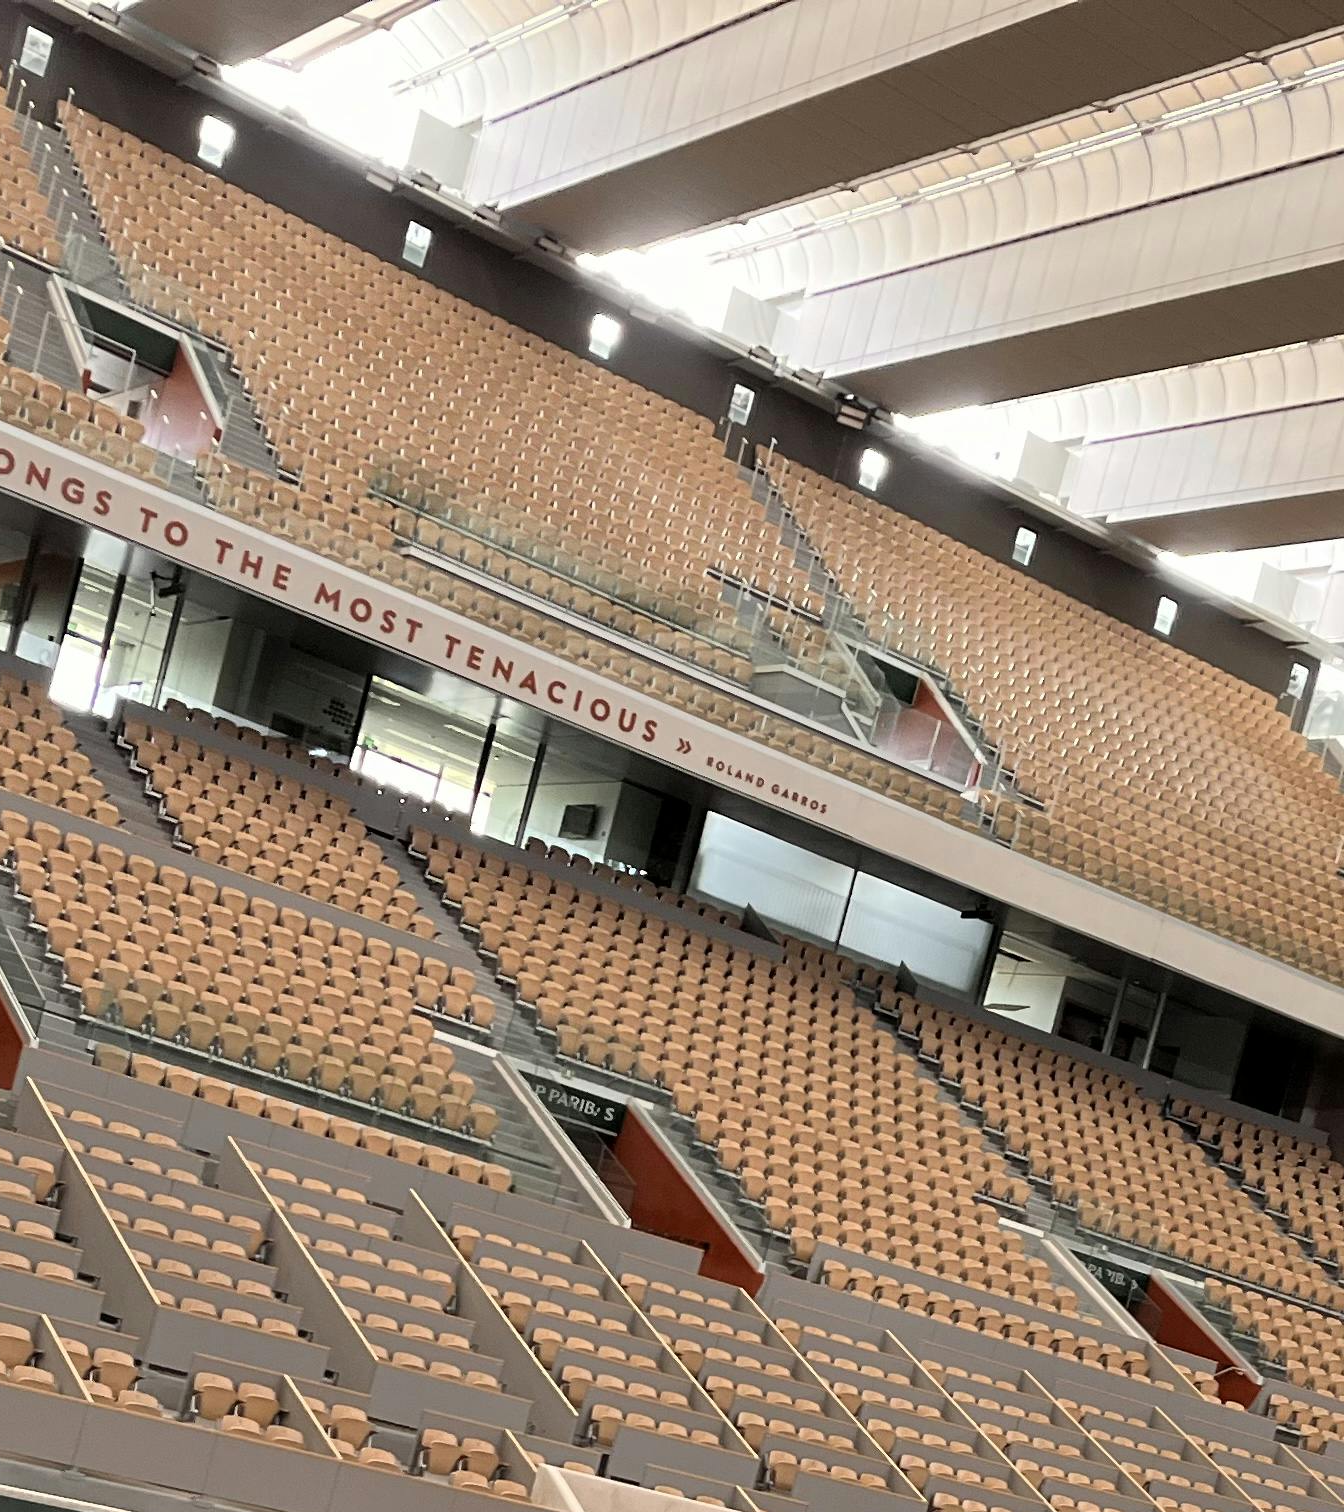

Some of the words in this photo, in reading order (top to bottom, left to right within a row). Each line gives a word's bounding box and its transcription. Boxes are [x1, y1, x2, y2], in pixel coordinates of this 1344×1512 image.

[139, 506, 190, 547] TO
[215, 538, 292, 591] THE
[314, 581, 424, 644] MOST
[444, 633, 659, 743] TENACIOUS
[706, 755, 765, 790] ROLAND
[770, 782, 828, 815] GARROS
